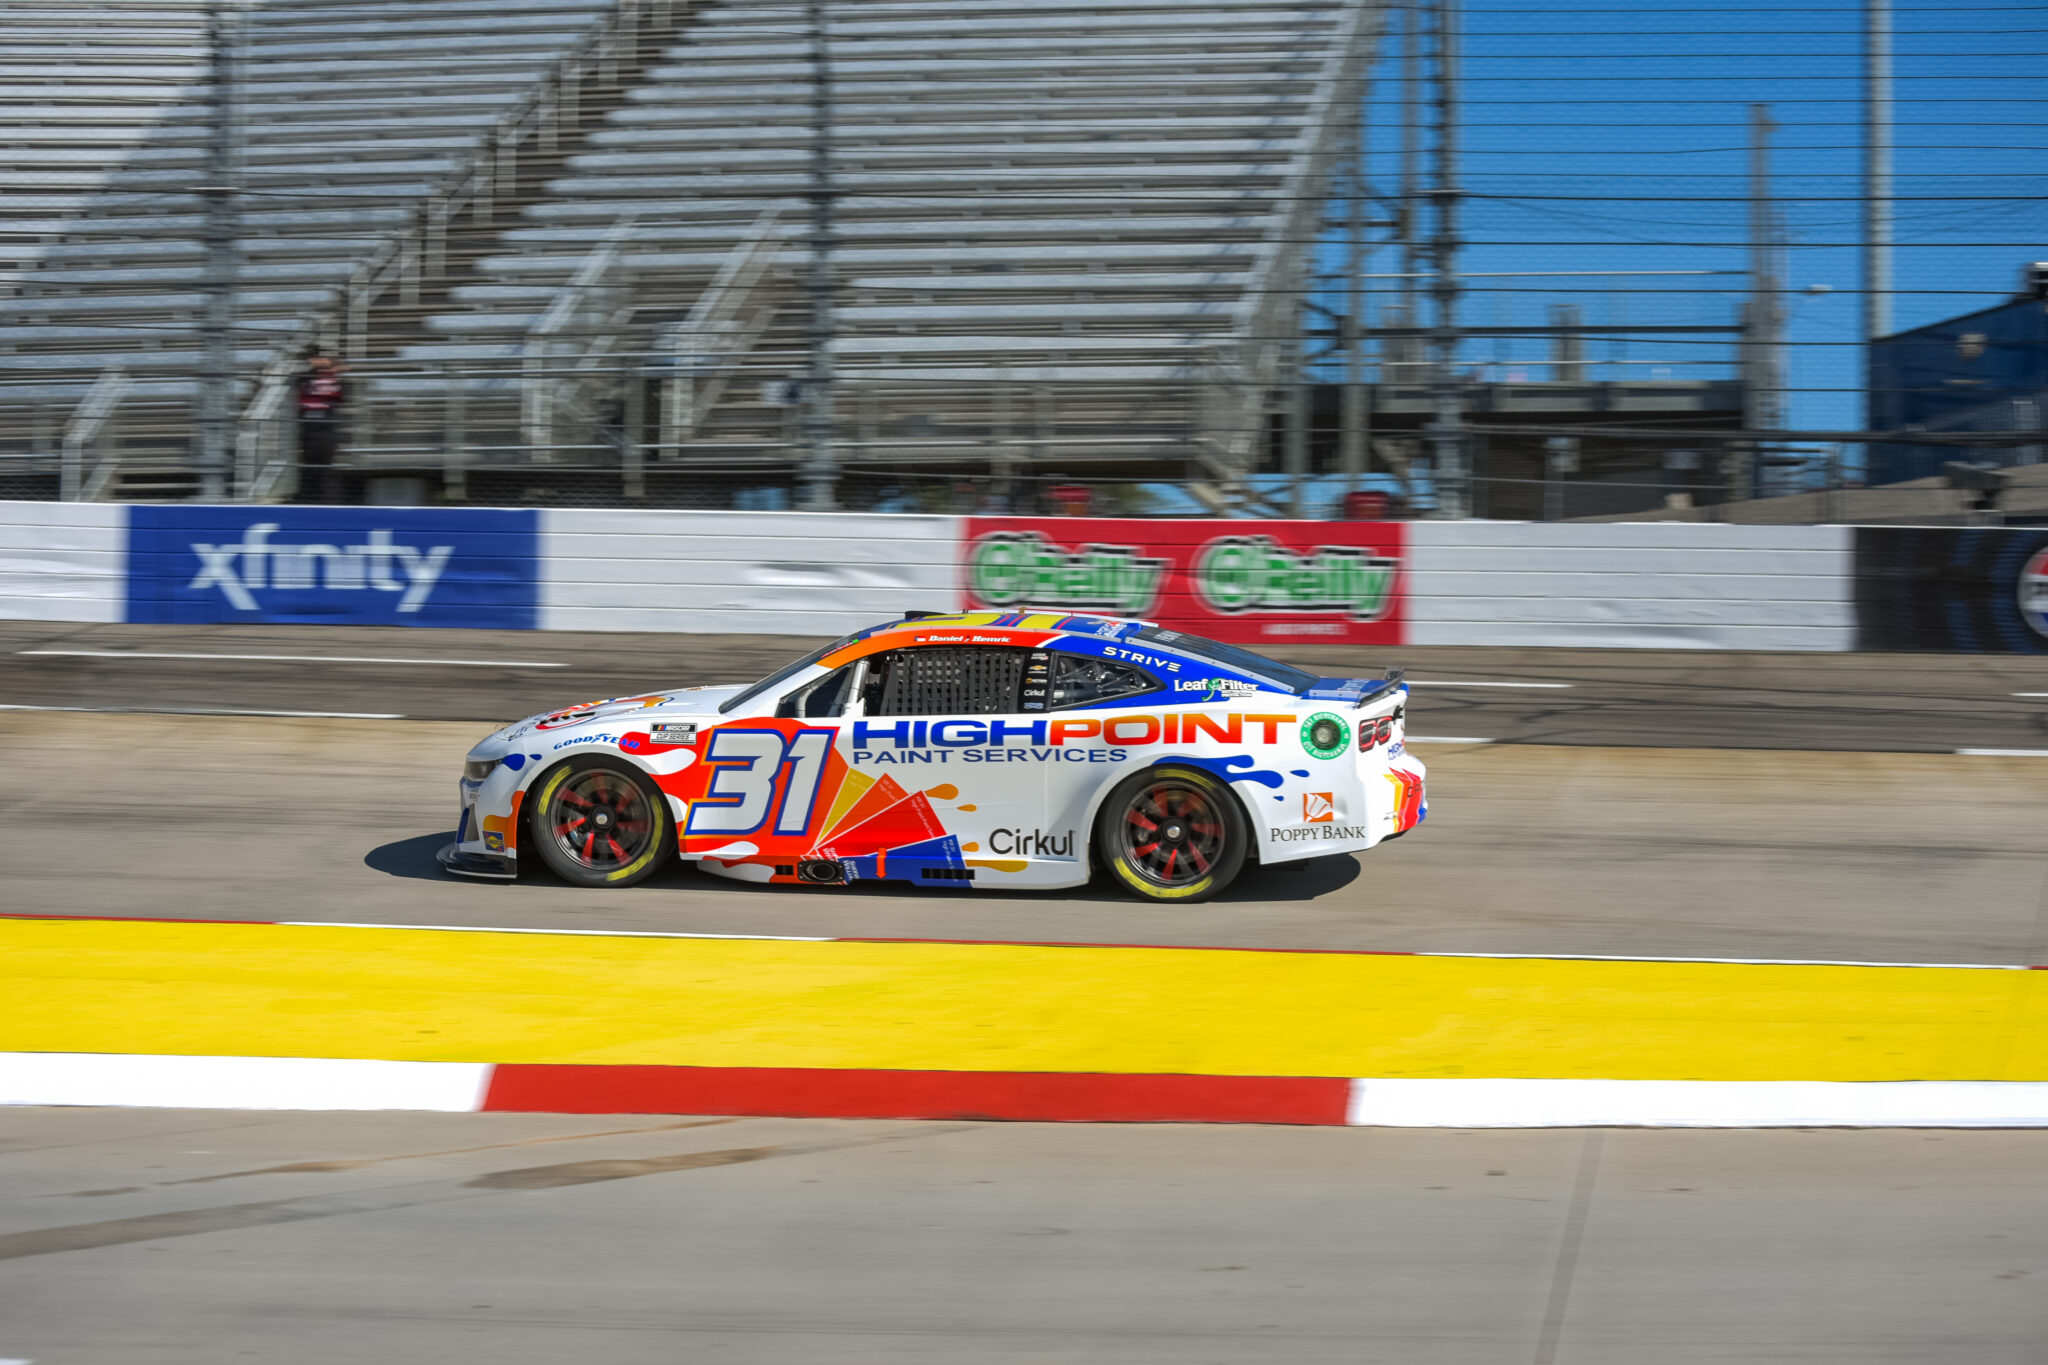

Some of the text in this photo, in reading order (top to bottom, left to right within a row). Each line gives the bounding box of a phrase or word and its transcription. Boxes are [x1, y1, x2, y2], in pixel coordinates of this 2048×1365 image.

[189, 523, 455, 613] xfinity
[972, 635, 1011, 643] Hemric
[1103, 646, 1182, 673] STRIVE
[1174, 678, 1260, 692] Leaf Filter
[553, 733, 641, 750] GOODYEAR
[853, 748, 1128, 765] PAINT SERVICES
[684, 728, 836, 836] 31
[989, 828, 1074, 856] Cirkul
[1271, 825, 1366, 842] POPPY BANK
